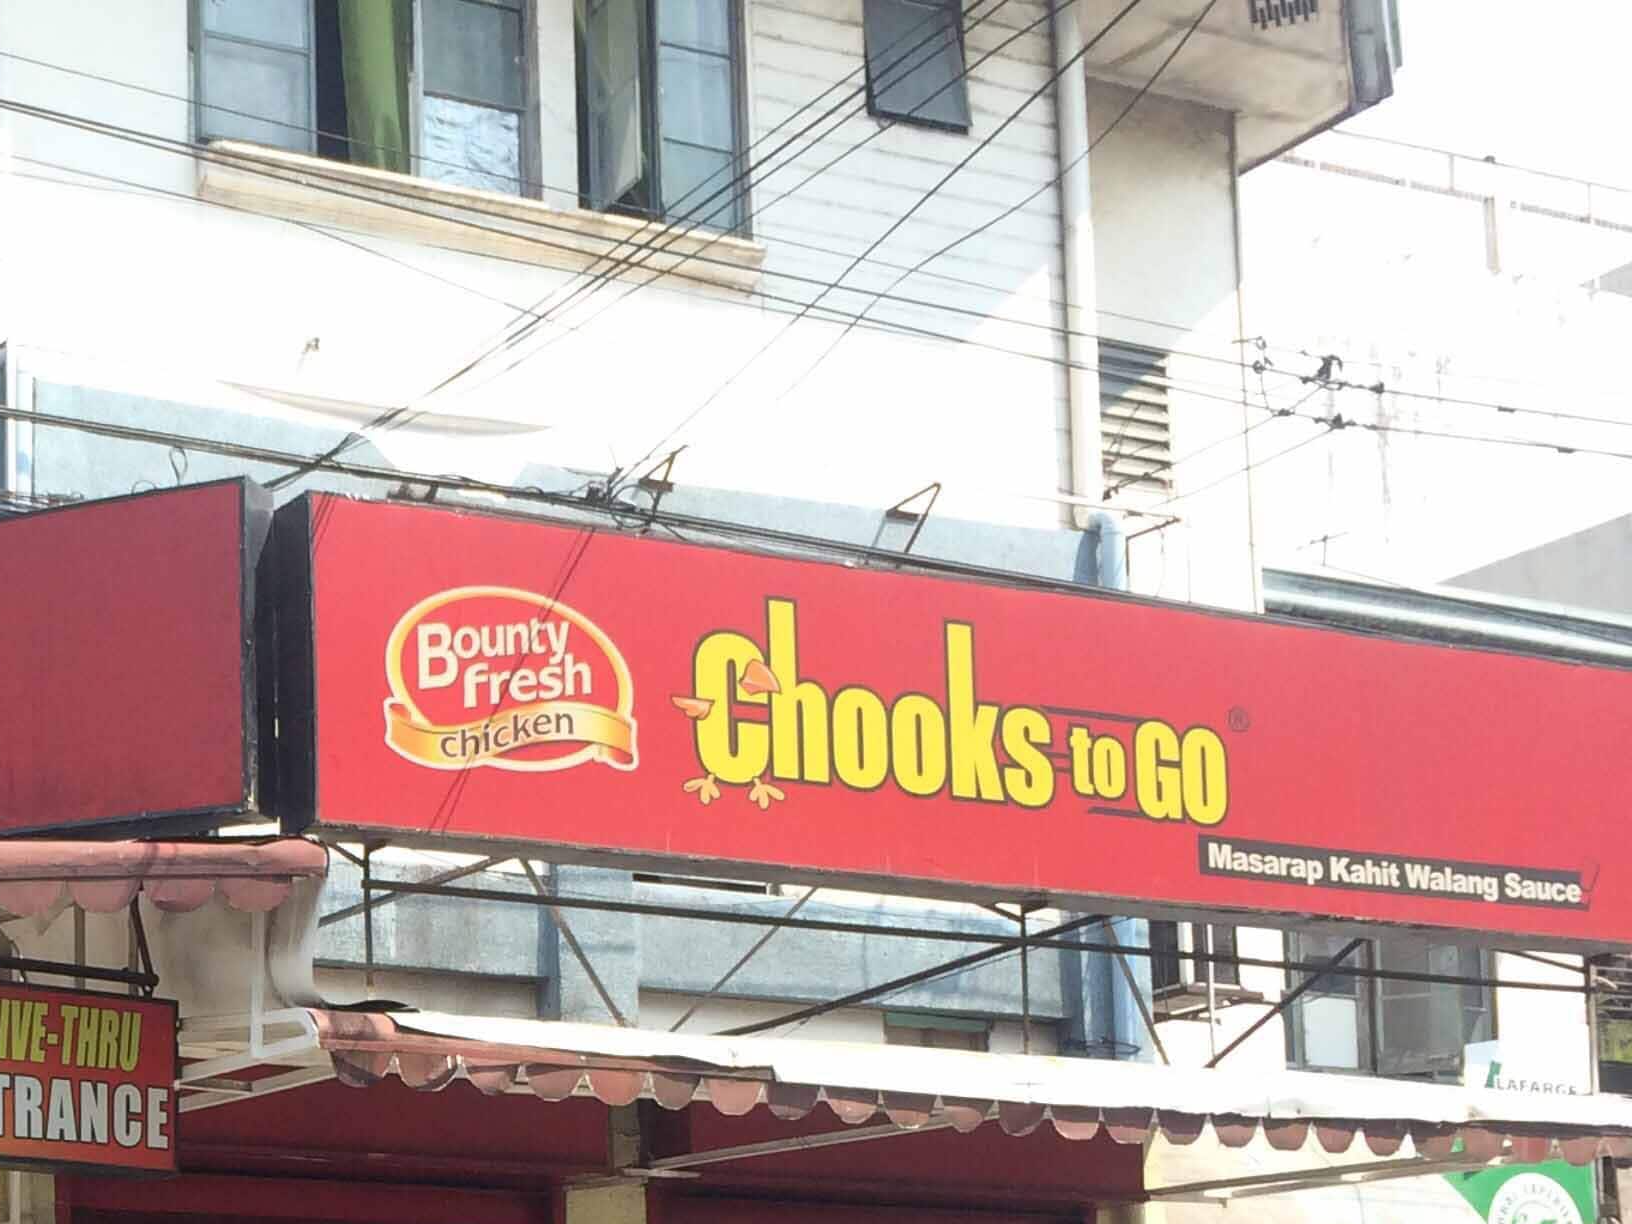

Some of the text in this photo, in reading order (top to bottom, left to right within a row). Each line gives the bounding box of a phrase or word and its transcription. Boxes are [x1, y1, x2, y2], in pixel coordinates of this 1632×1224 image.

[417, 618, 570, 690] Bounty
[440, 712, 575, 758] chicken
[1069, 726, 1126, 799] to
[1134, 720, 1228, 825] GO
[1207, 842, 1582, 904] Masarap Kahit Walang Sauce
